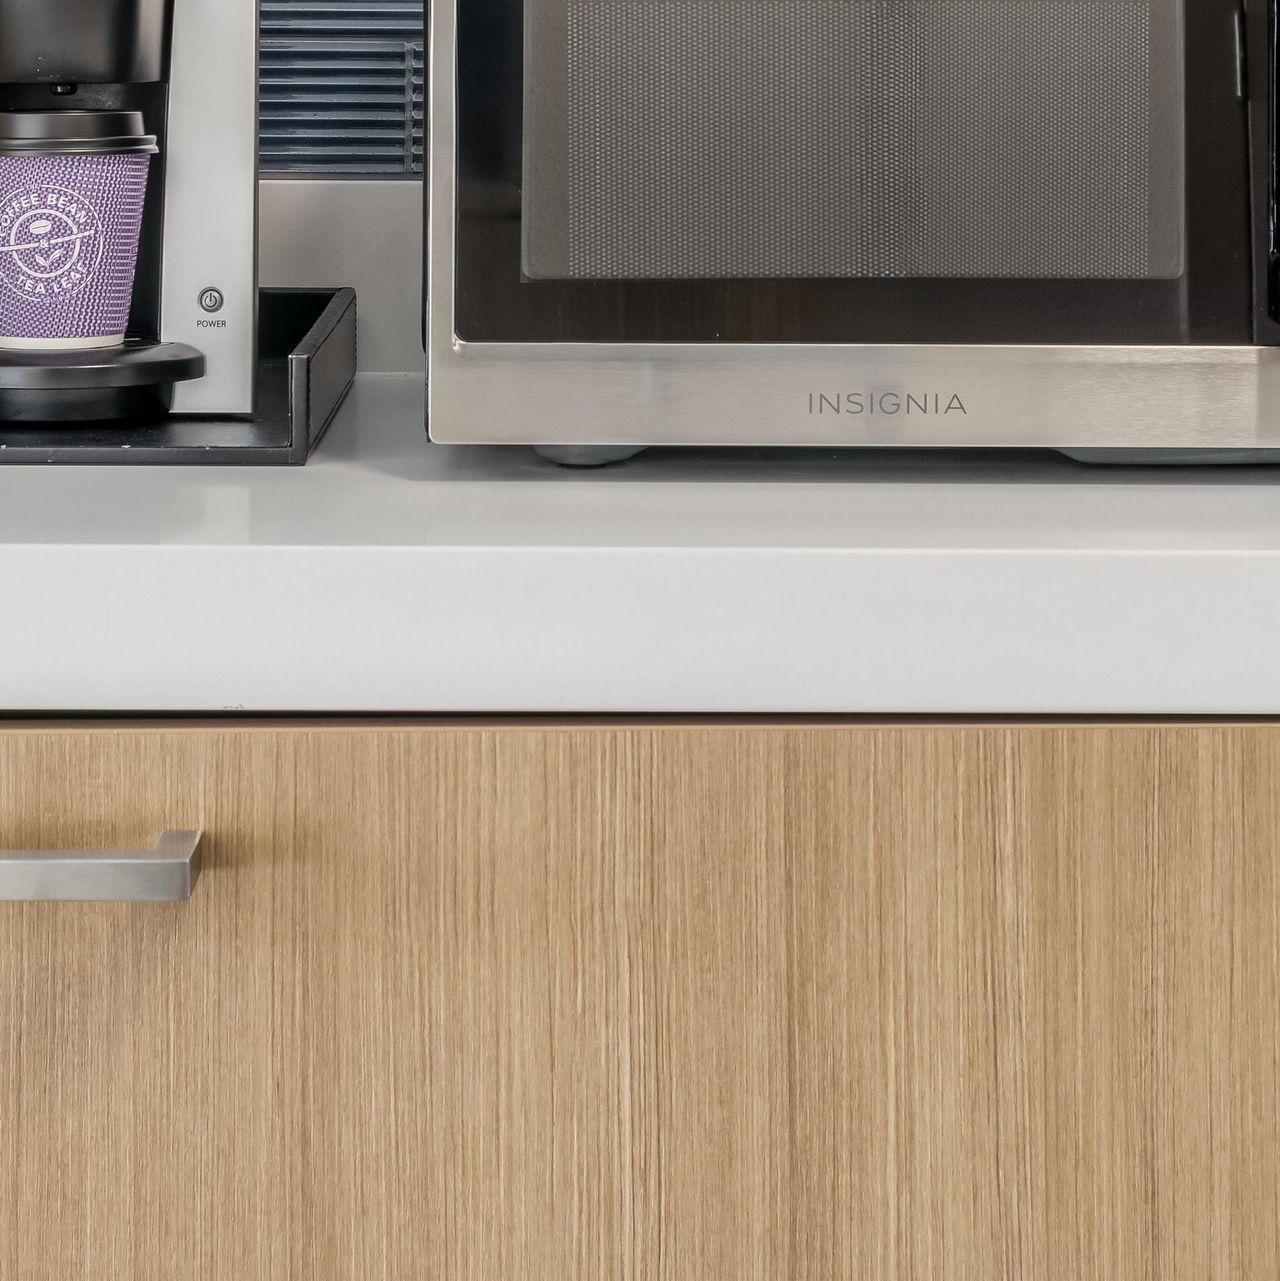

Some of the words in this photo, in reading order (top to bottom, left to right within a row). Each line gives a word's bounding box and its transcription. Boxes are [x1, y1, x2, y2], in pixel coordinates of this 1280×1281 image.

[46, 193, 89, 224] BEAN
[39, 238, 50, 249] &
[17, 275, 46, 294] TEA
[53, 261, 88, 293] LEAF
[196, 320, 227, 328] POWER
[808, 392, 968, 415] INSIGNIA
